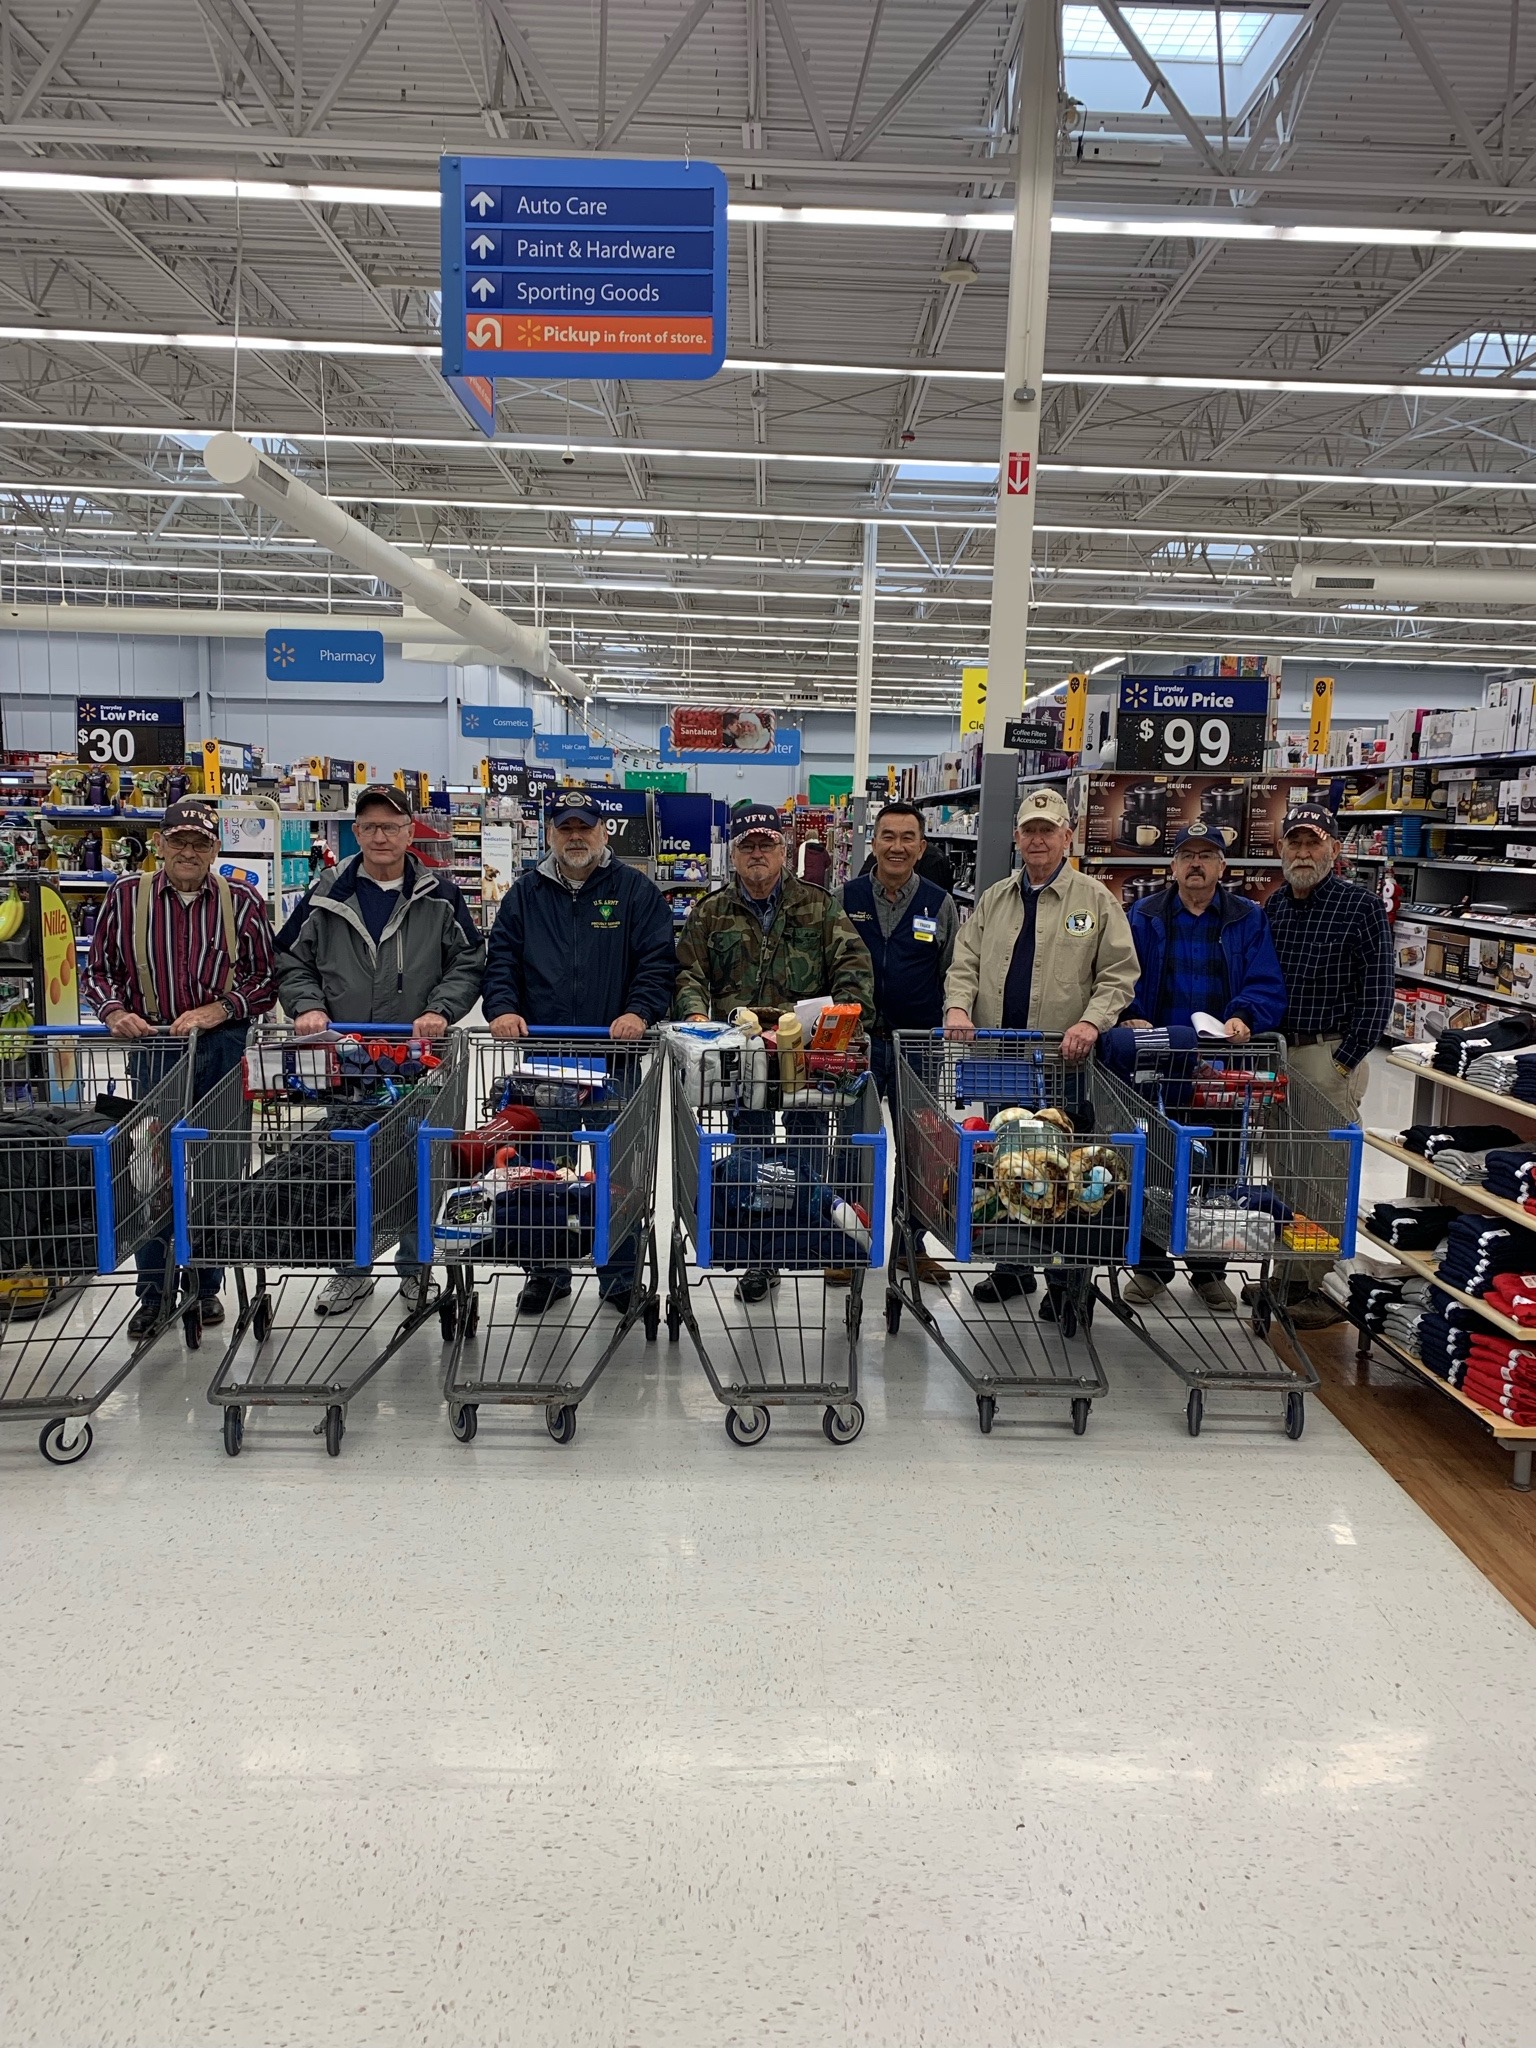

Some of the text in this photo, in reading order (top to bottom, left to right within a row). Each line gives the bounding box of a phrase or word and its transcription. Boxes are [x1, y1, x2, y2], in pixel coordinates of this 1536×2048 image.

[517, 197, 607, 215] Auto Care
[517, 240, 676, 259] Paint & Hardware
[517, 282, 660, 305] Sporting Goods
[543, 326, 707, 345] Pickup in front of store.
[319, 649, 376, 665] Pharmacy
[1154, 685, 1185, 693] Everyday
[1153, 692, 1234, 708] Low Price
[100, 710, 159, 721] Low Price
[493, 718, 529, 727] Cosmetics
[1068, 718, 1074, 731] J
[1314, 721, 1321, 734] J
[680, 727, 718, 736] Santaland
[1012, 728, 1047, 738] Coffee Filters
[1016, 736, 1047, 745] Accessories
[1312, 740, 1319, 751] 2
[774, 744, 793, 754] nter
[599, 799, 623, 811] rice
[181, 810, 208, 821] VFW
[743, 814, 767, 824] VFW
[1297, 811, 1320, 820] VFW
[43, 909, 67, 937] Nilla
